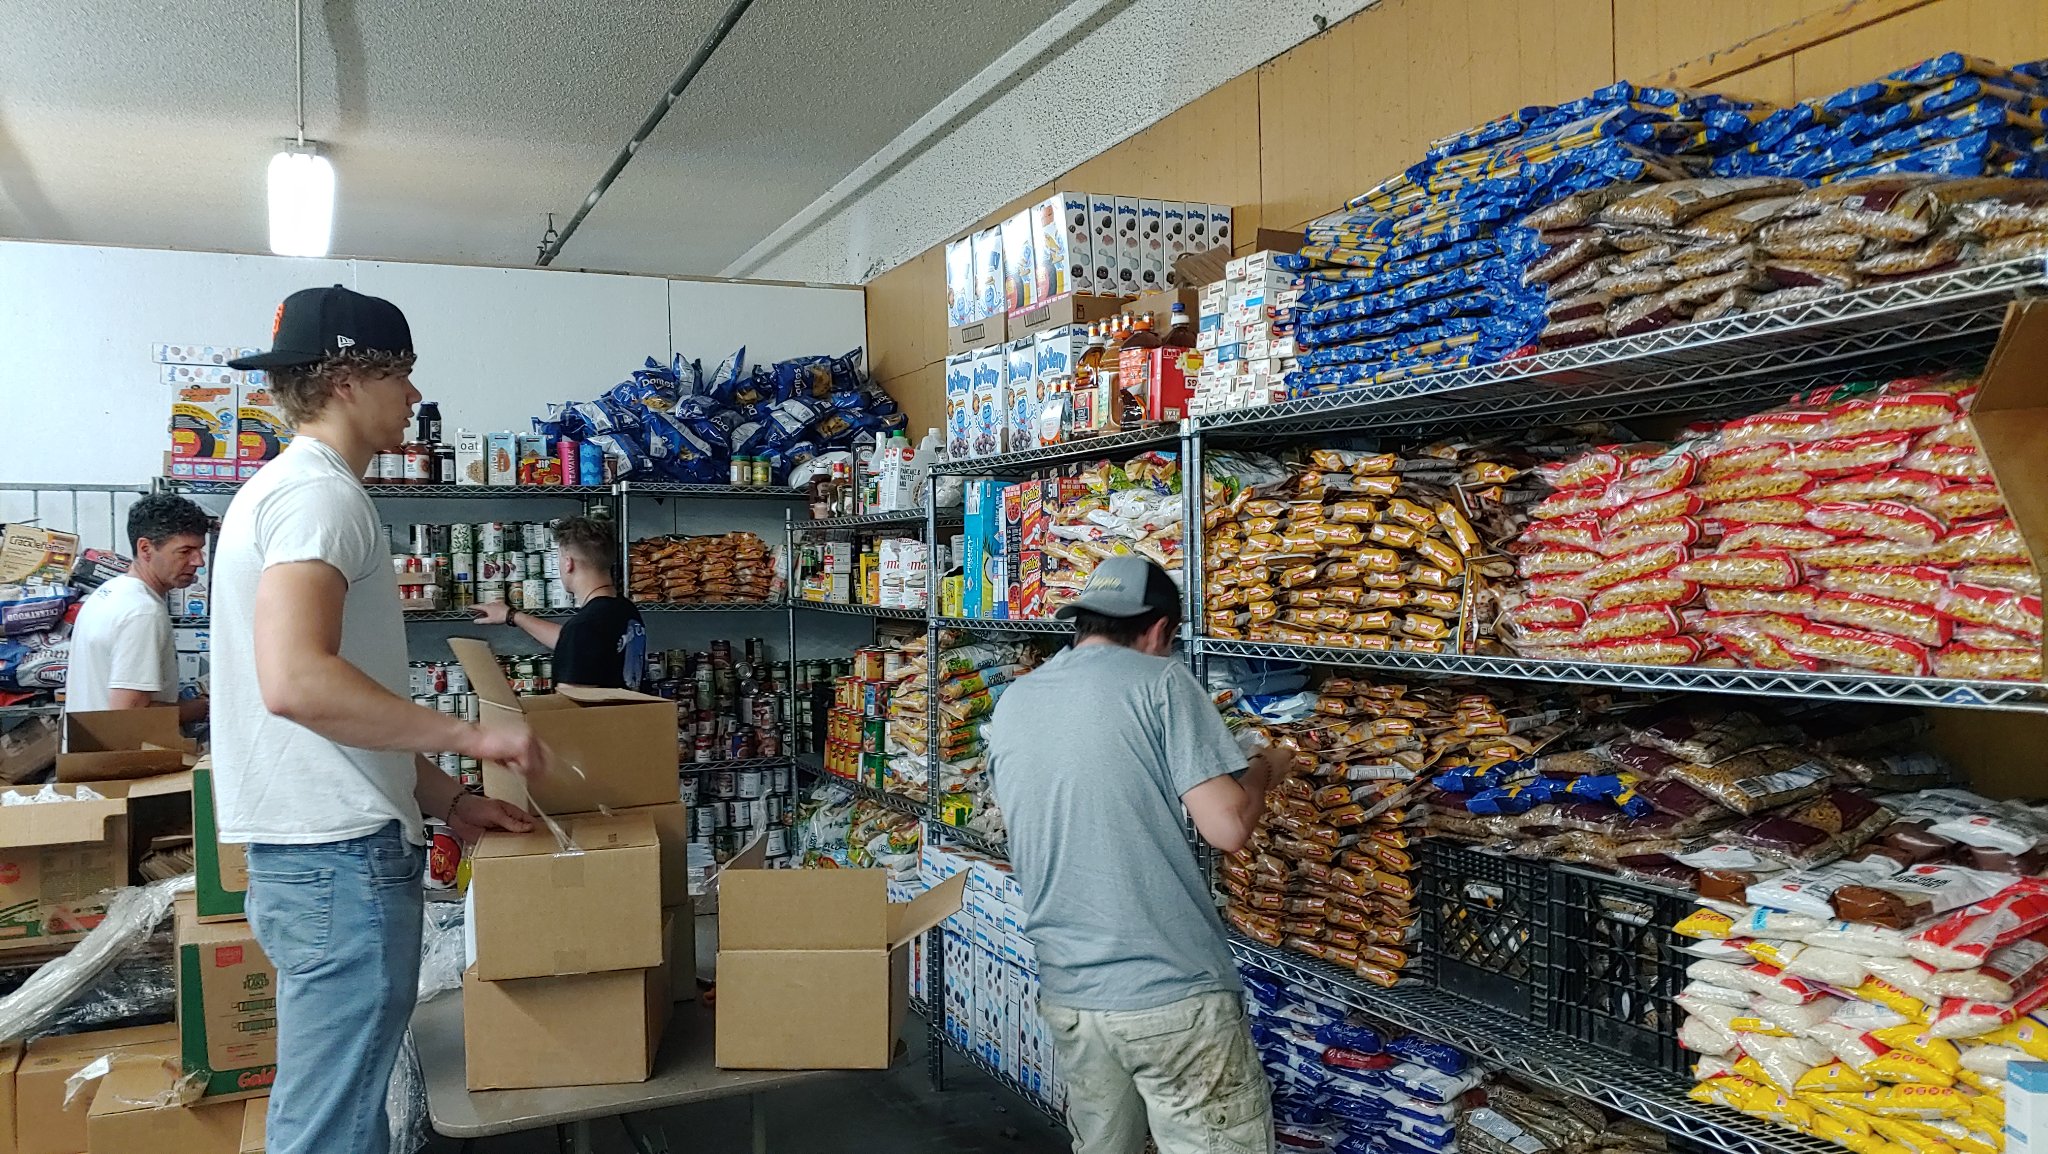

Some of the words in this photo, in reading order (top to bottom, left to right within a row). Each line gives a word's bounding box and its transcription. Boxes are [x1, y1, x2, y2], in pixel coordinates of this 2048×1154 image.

[641, 378, 675, 390] Doritos
[460, 441, 479, 451] oat
[567, 449, 575, 485] TEAVANA
[40, 668, 67, 682] KINGS
[237, 1067, 276, 1088] Gold
